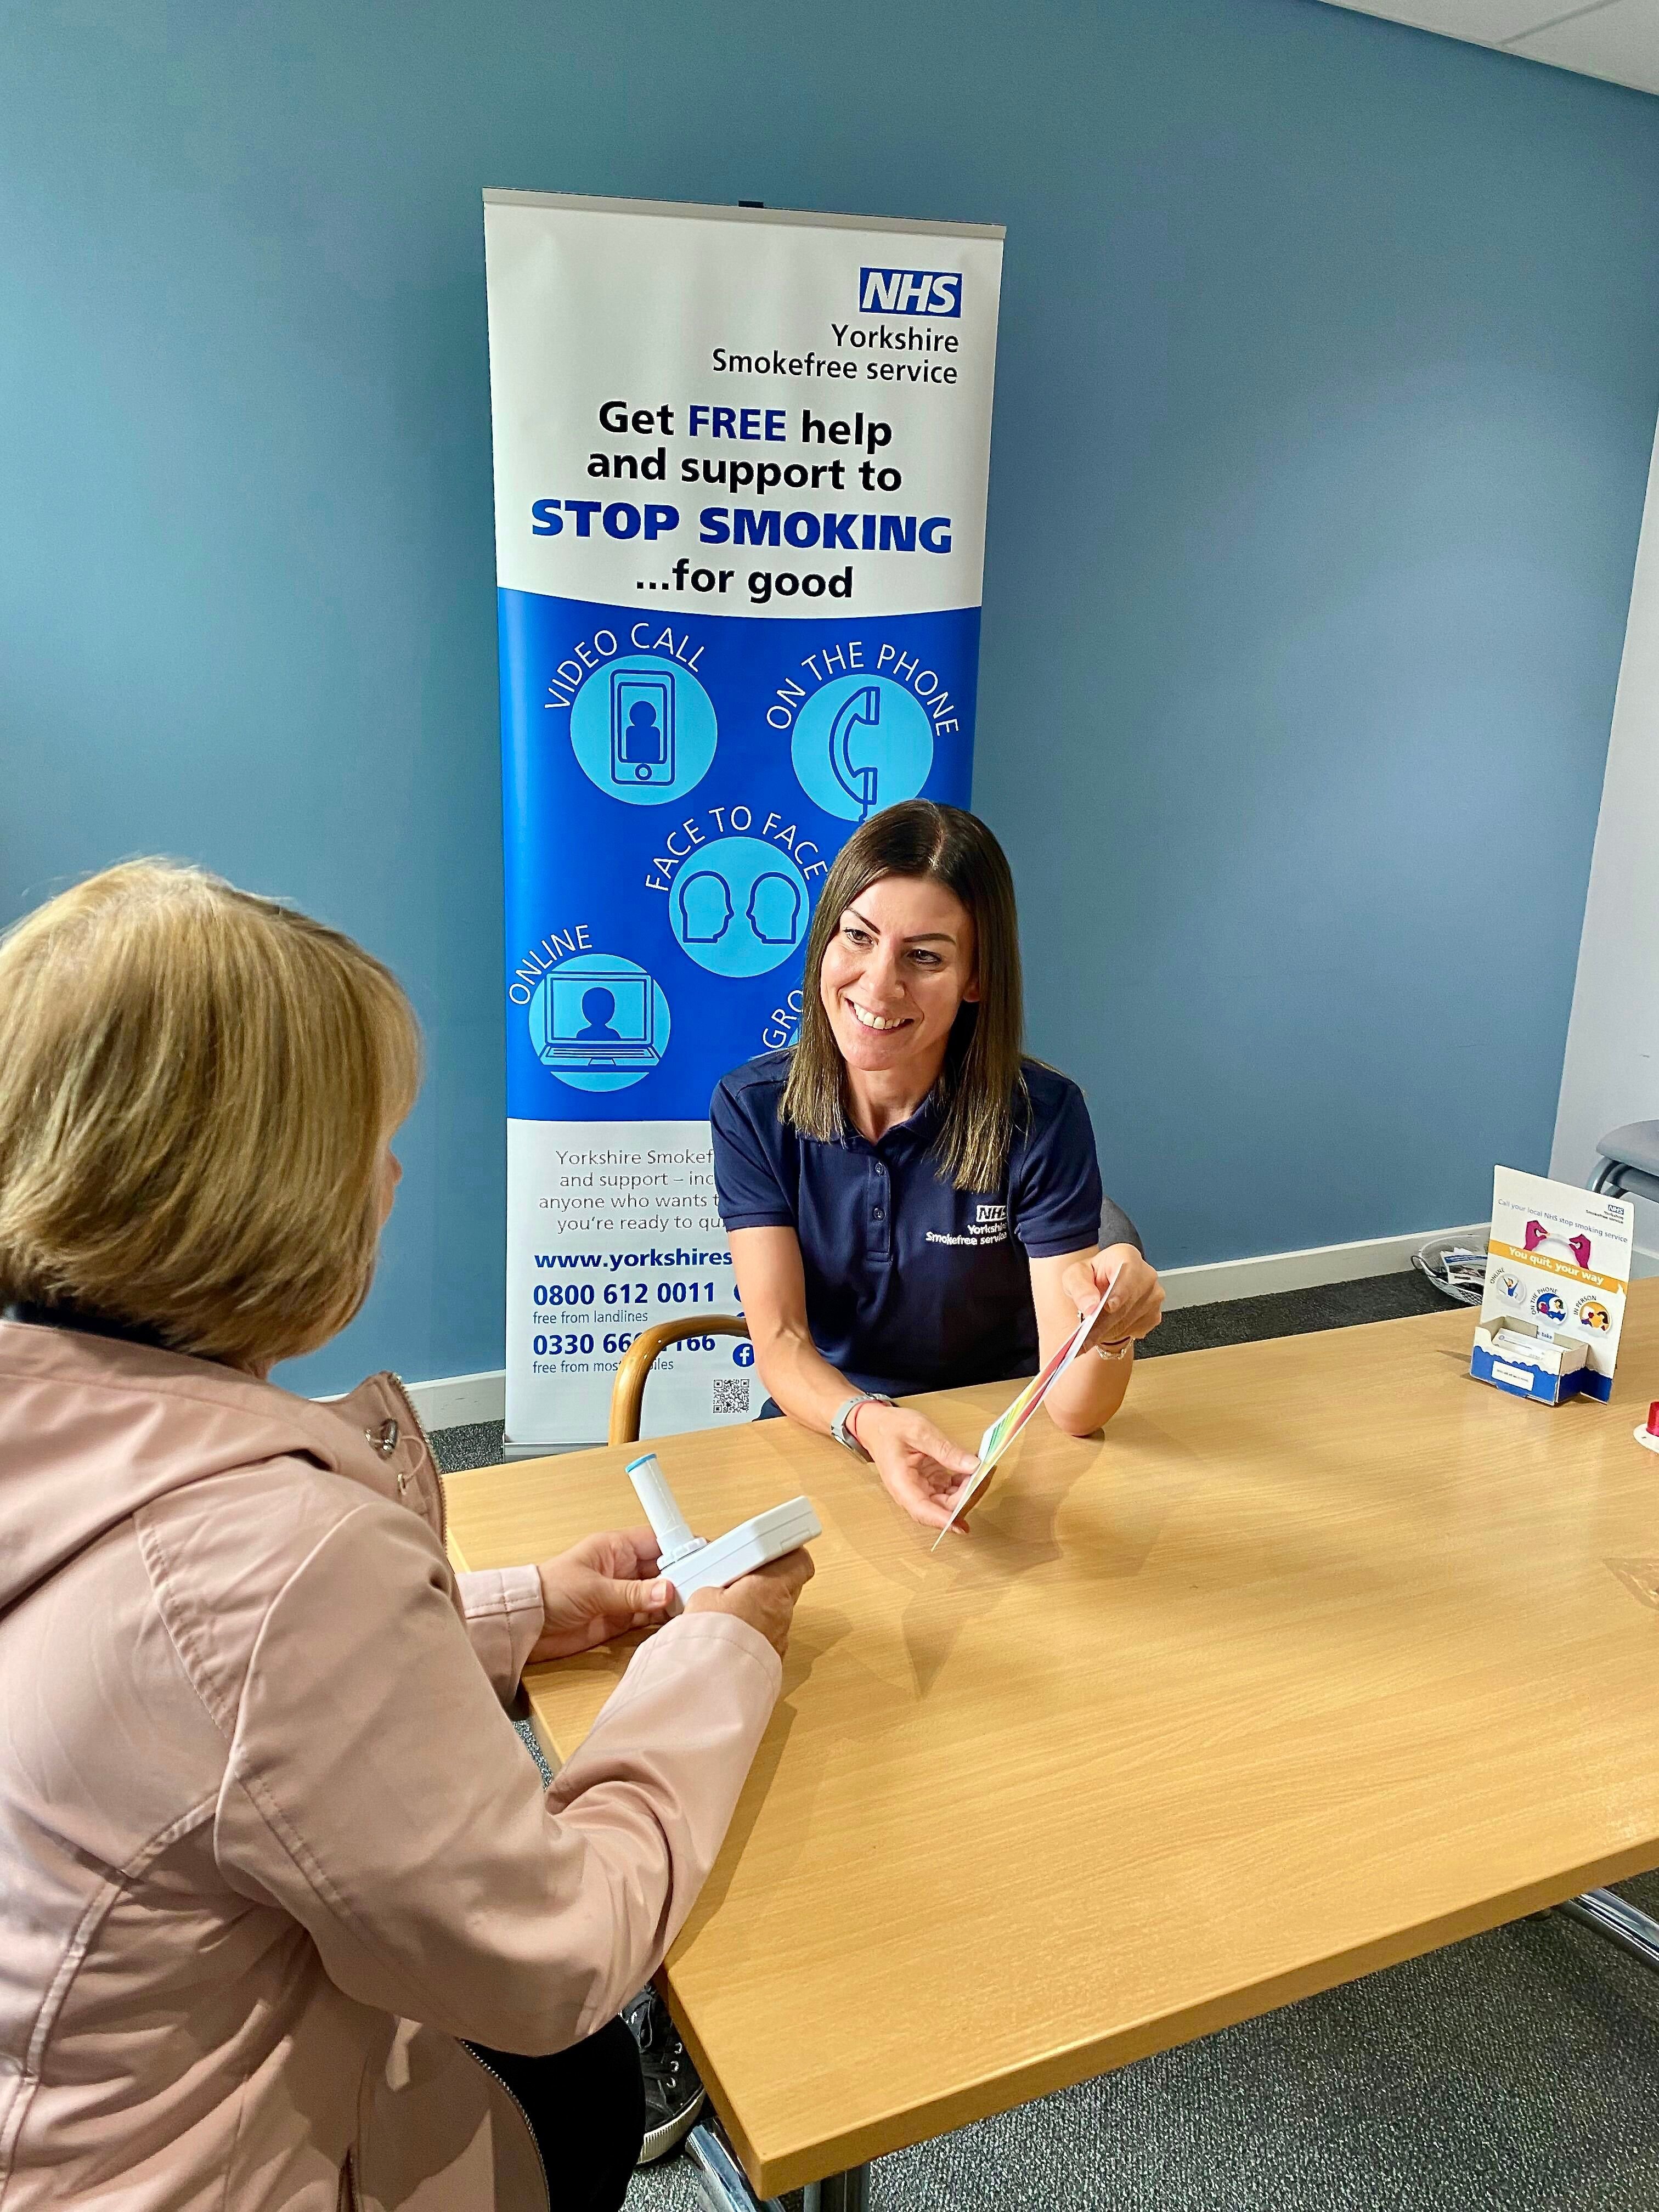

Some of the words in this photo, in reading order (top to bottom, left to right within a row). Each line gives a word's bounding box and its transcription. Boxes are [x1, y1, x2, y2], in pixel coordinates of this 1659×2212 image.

[862, 270, 959, 314] NHS
[831, 324, 958, 352] Yorkshire
[713, 348, 857, 379] Smokefree
[867, 359, 958, 384] service
[600, 401, 674, 435] Get
[690, 405, 786, 442] FREE
[802, 409, 891, 454] help
[588, 447, 665, 480] and
[682, 458, 845, 495] support
[859, 460, 901, 491] to
[532, 499, 679, 540] STOP
[700, 507, 951, 554] SMOKING
[748, 566, 853, 603] good
[545, 630, 617, 710] VIDEO
[631, 622, 705, 672] CALL
[767, 678, 805, 729] ON
[802, 642, 864, 680] THE
[877, 644, 958, 736] PHONE
[646, 819, 705, 893] FACE
[709, 806, 751, 832] TO
[763, 812, 828, 881] FACE
[509, 925, 593, 1005] ONLINE
[556, 1150, 641, 1165] Yorkshire
[560, 1172, 593, 1187] and
[600, 1173, 668, 1189] support
[539, 1195, 604, 1212] anyone
[611, 1193, 649, 1209] who
[656, 1194, 707, 1207] wants
[1609, 1205, 1624, 1214] NHS
[621, 1215, 669, 1232] ready
[674, 1216, 692, 1228] to
[1498, 1199, 1510, 1207] Call
[1527, 1207, 1542, 1217] local
[1544, 1213, 1558, 1221] NHS
[1559, 1218, 1573, 1226] stop
[1575, 1223, 1602, 1235] smoking
[1605, 1231, 1628, 1243] service
[926, 1231, 978, 1246] Smokefree
[534, 1248, 732, 1271] www.yorkshires
[1509, 1247, 1528, 1260] You
[1554, 1263, 1579, 1276] your
[1581, 1272, 1604, 1285] way
[1490, 1267, 1505, 1284] ONLINE
[534, 1285, 594, 1305] 0800
[604, 1284, 647, 1304] 612
[658, 1282, 713, 1303] 0011
[1576, 1295, 1596, 1308] PERSON
[533, 1312, 556, 1323] free
[561, 1311, 589, 1323] from
[595, 1310, 647, 1322] landlines
[1530, 1306, 1537, 1315] ON
[534, 1334, 594, 1355] 0330
[603, 1333, 643, 1353] 66
[533, 1361, 556, 1373] free
[560, 1361, 588, 1372] from
